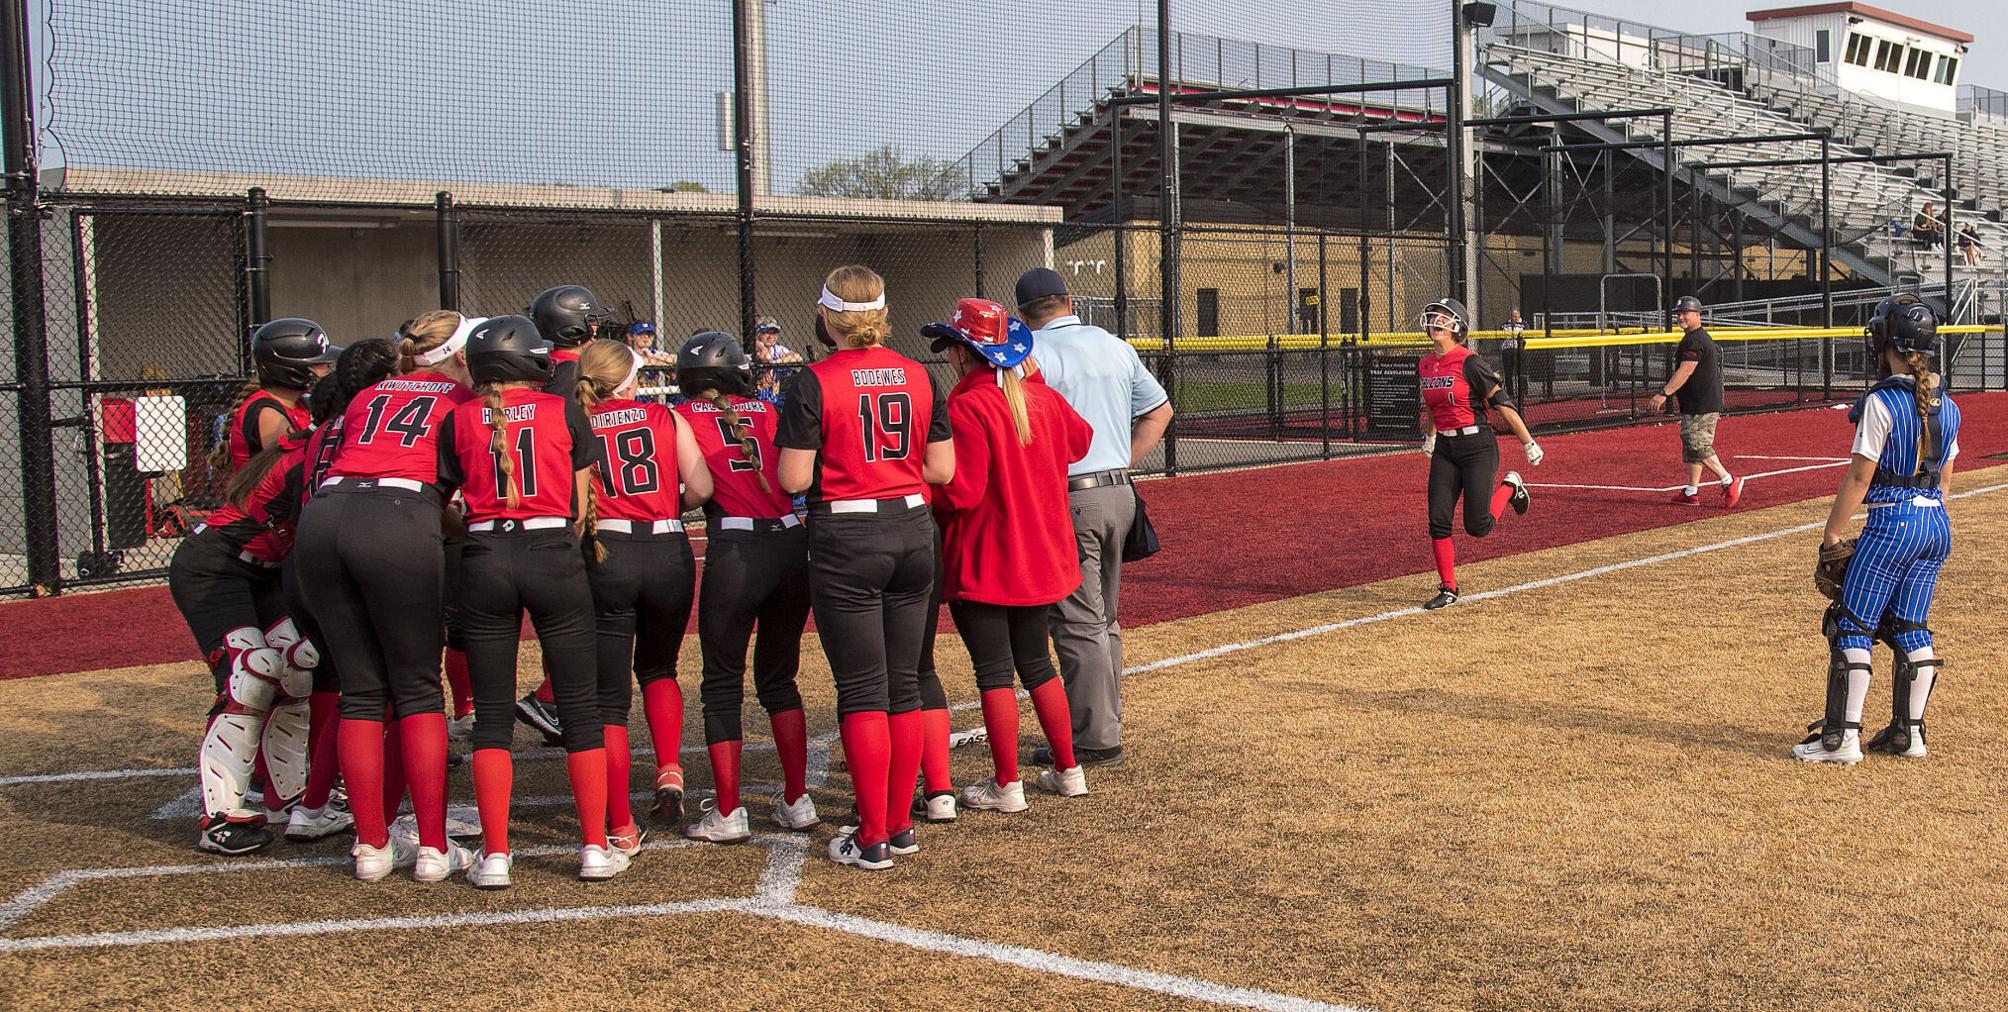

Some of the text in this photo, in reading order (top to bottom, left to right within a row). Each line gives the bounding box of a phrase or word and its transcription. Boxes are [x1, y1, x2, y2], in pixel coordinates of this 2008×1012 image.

[375, 379, 456, 394] KWITCHOFF
[851, 367, 907, 387] BODEWES
[1420, 376, 1456, 390] ALCONS
[358, 393, 438, 448] 14
[482, 403, 537, 425] HRLEY
[591, 408, 648, 429] DIRIENZO
[858, 392, 913, 463] 19
[715, 416, 764, 473] 5
[489, 427, 538, 500] 11
[593, 426, 660, 499] 18
[956, 734, 988, 748] EAS
